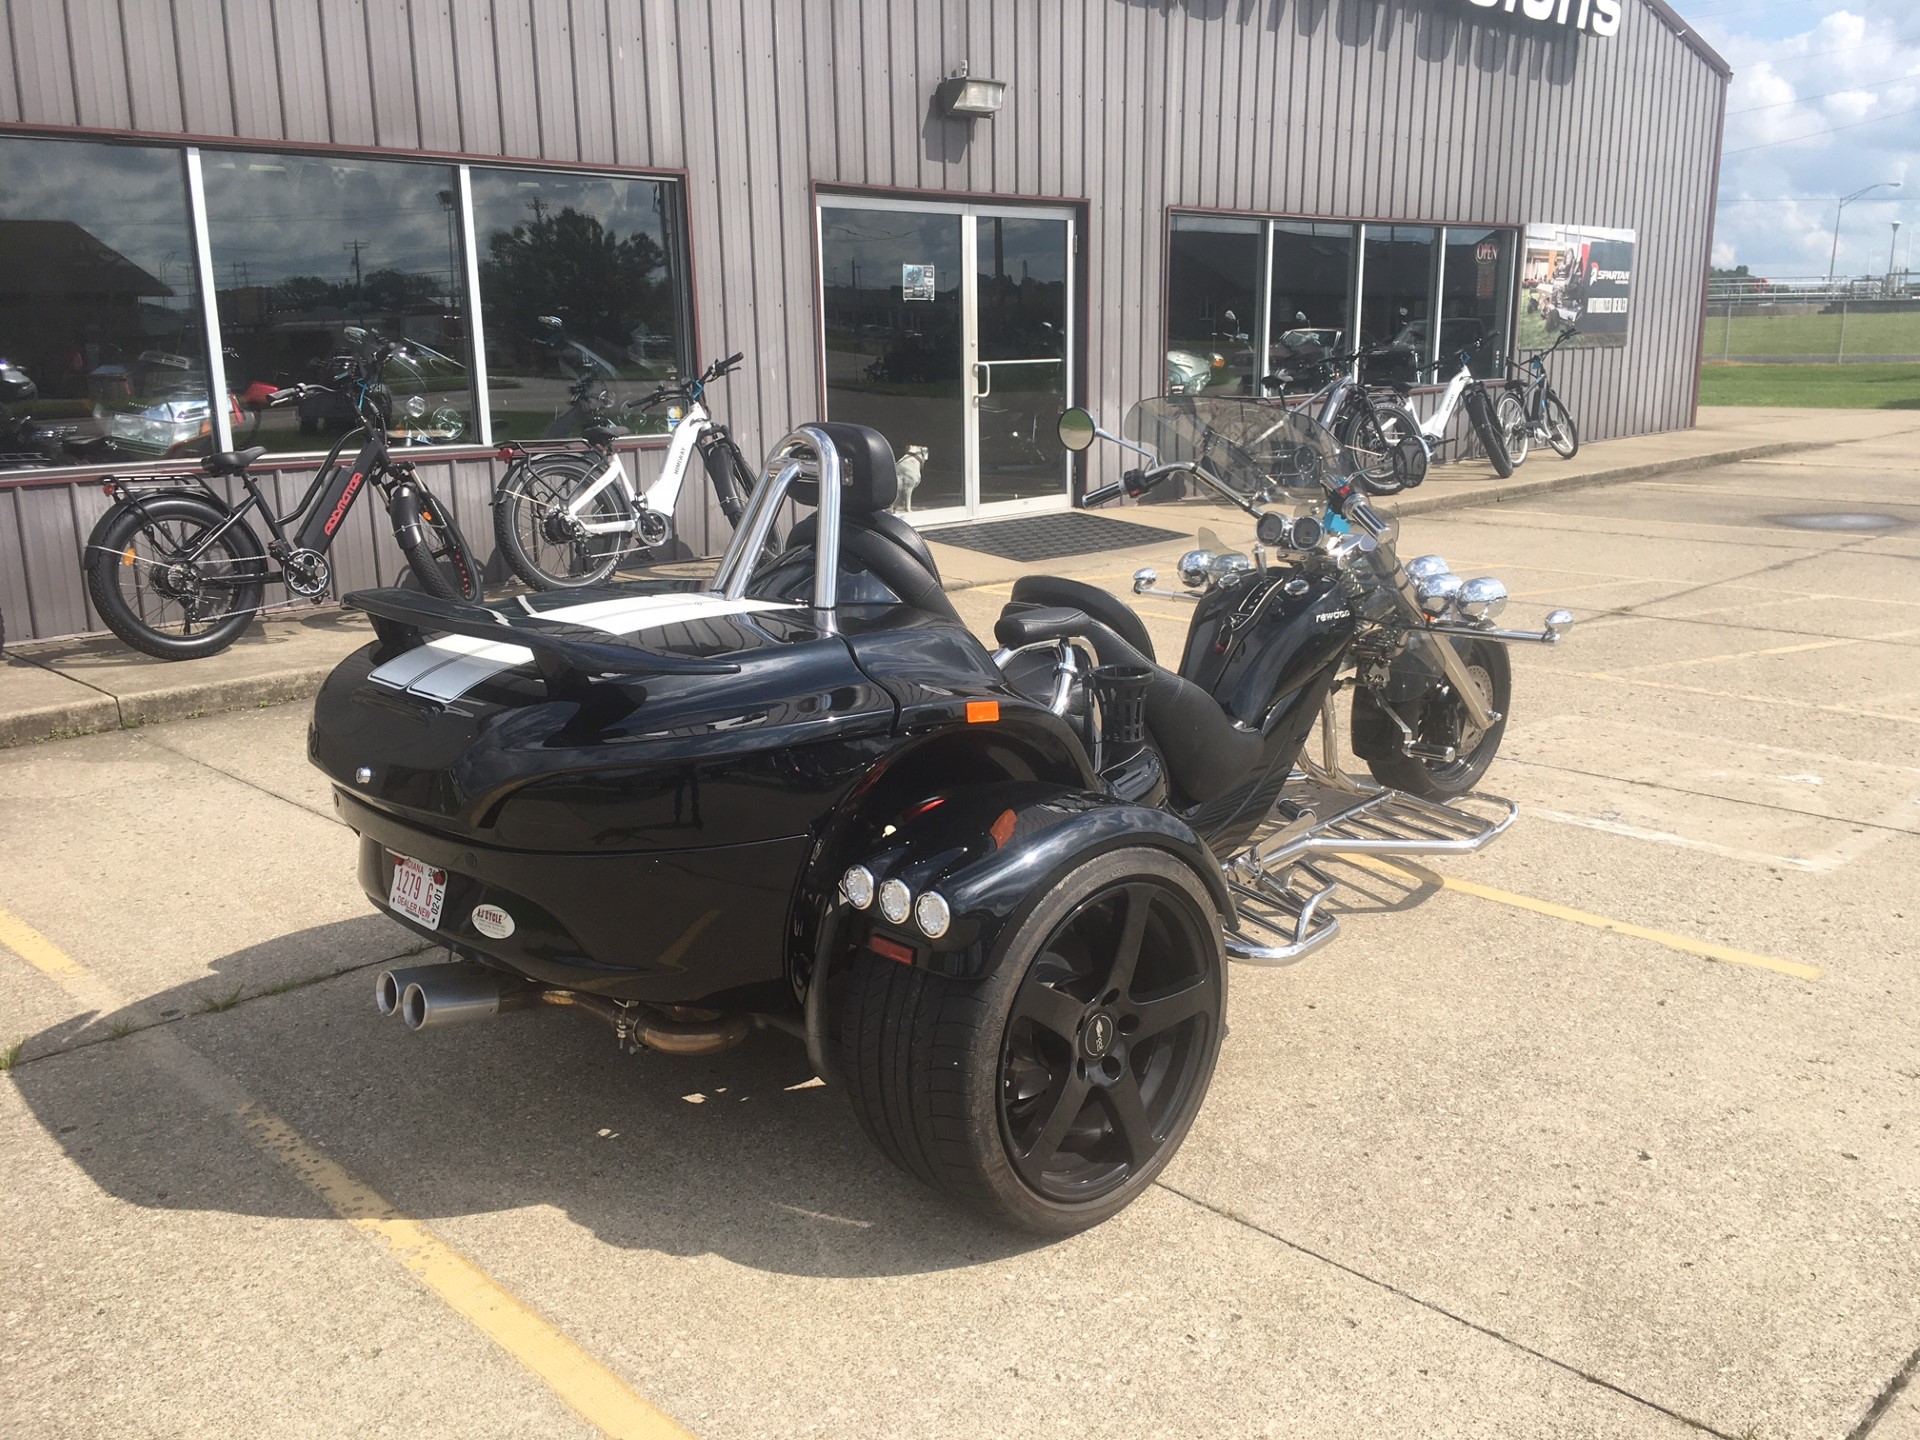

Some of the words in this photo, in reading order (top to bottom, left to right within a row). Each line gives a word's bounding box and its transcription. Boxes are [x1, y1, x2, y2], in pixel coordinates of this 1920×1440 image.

[1477, 243, 1498, 260] OPEN
[1597, 270, 1630, 280] SPARTAN
[674, 447, 686, 475] HIMIWAY
[402, 858, 424, 875] NDIANA
[397, 868, 422, 900] 1279
[425, 883, 434, 907] G
[397, 896, 418, 913] DEALER
[418, 906, 432, 920] NEW
[431, 889, 443, 915] 02-01
[485, 910, 503, 925] CYCLE
